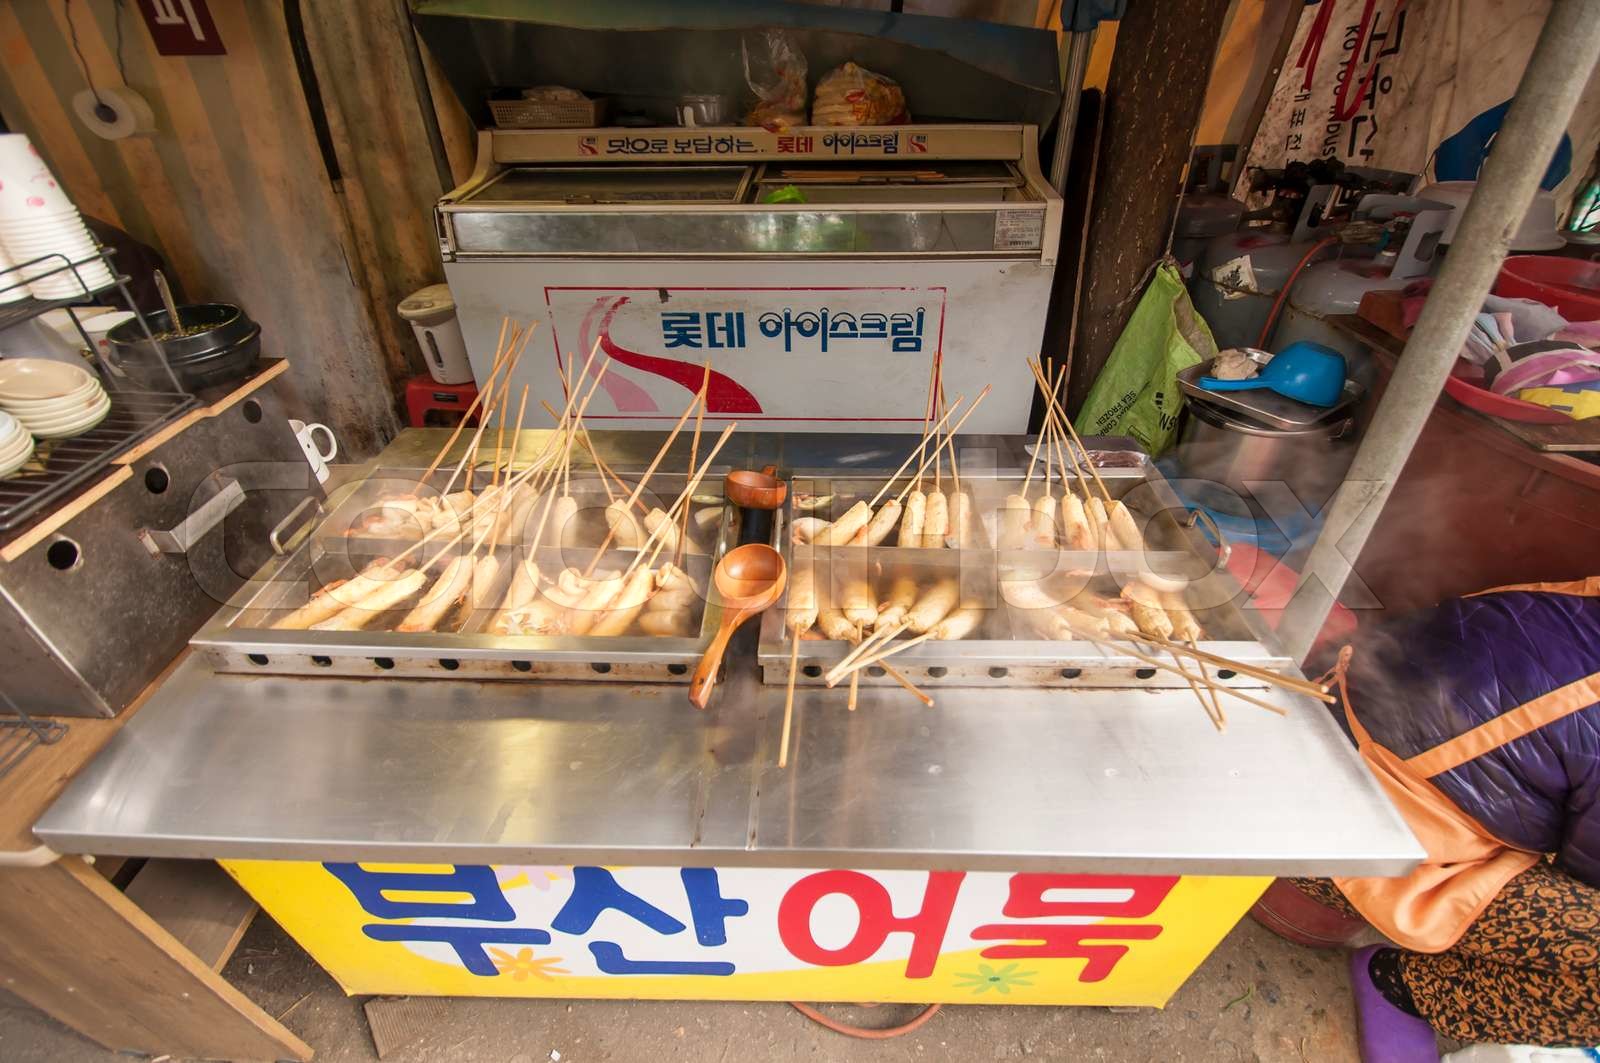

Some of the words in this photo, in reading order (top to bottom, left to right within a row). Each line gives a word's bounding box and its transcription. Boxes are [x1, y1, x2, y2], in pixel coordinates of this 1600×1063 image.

[1347, 10, 1407, 162] 고유산
[606, 136, 671, 154] 맛으로
[777, 136, 813, 153] 롯데
[822, 132, 898, 154] 아이스크림
[1322, 105, 1342, 160] INDUS
[660, 311, 746, 349] 롯데
[758, 306, 926, 353] 아이스크림
